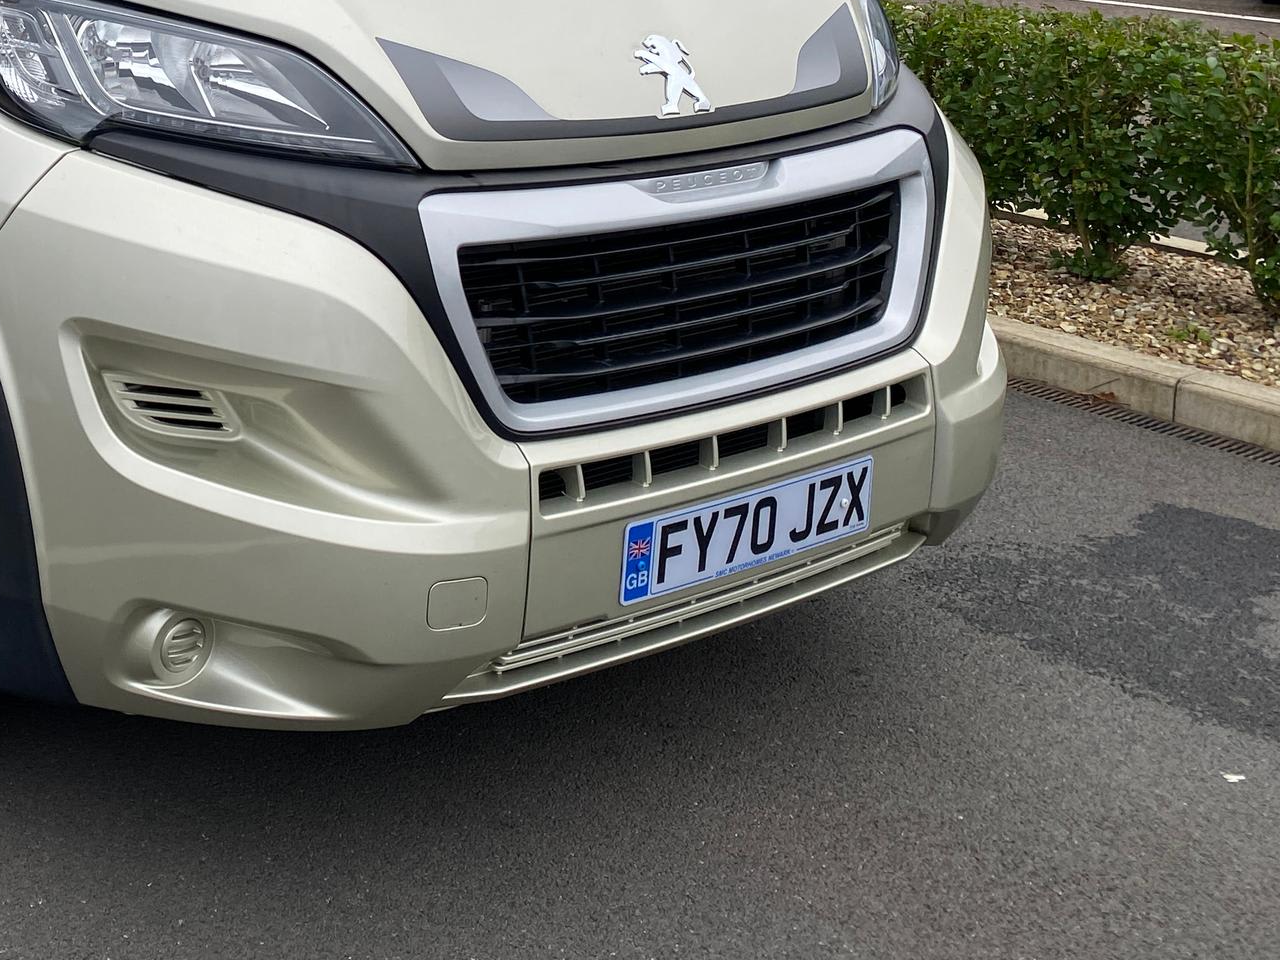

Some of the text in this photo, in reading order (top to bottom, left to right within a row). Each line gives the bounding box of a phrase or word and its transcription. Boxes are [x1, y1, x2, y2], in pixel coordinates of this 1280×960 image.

[656, 167, 757, 193] PEUGEOT
[656, 466, 869, 585] FY70 JZX
[715, 549, 791, 577] SMC MOTORHOMES NEWARK
[625, 570, 648, 591] GB
